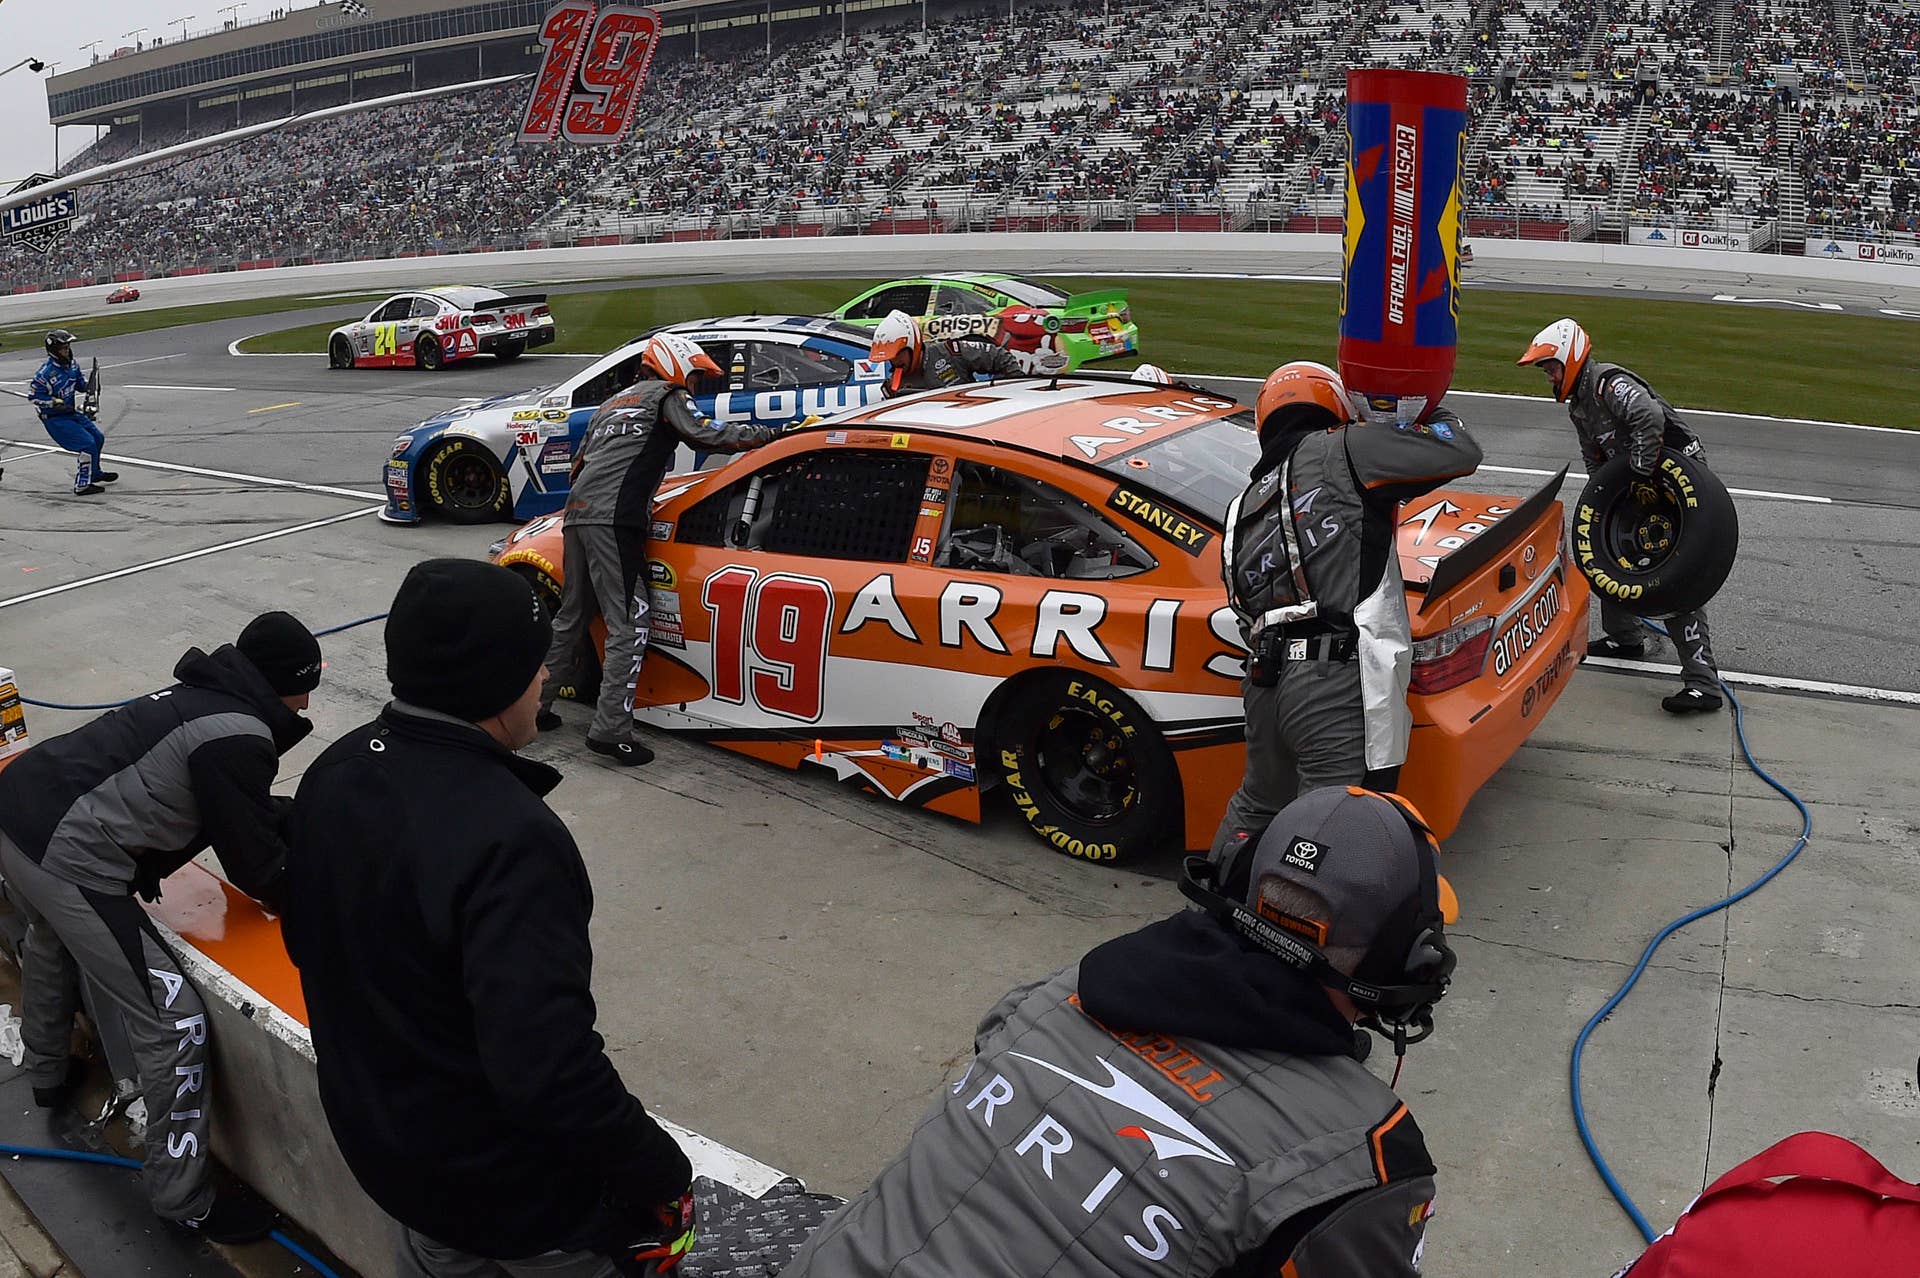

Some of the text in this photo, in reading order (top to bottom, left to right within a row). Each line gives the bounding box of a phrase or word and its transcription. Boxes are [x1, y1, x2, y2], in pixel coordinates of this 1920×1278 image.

[516, 1, 663, 144] 19
[1395, 126, 1416, 193] NASCAR
[10, 198, 68, 228] LOWE'S
[15, 222, 65, 240] RACING
[1406, 227, 1414, 242] OF
[1701, 234, 1740, 247] QuikTrip
[1877, 247, 1914, 261] QuikTrip
[1389, 223, 1407, 324] OFFICIAL FUEL
[434, 313, 460, 330] 3M
[503, 312, 528, 329] 3M
[928, 316, 993, 336] CRISPY
[374, 323, 397, 356] 24
[517, 432, 538, 444] 3M
[592, 423, 643, 439] RRIS
[1070, 397, 1234, 458] ARRIS
[429, 442, 463, 504] GOODYEAR
[1661, 458, 1697, 508] EAGLE
[494, 477, 509, 512] EAGLE
[1114, 489, 1204, 546] STANLEY
[499, 548, 554, 572] GOODYEAR
[912, 537, 931, 555] J5
[1245, 515, 1340, 587] ARIS
[1577, 504, 1642, 600] GOODYEAR
[537, 572, 561, 595] EAG
[1451, 600, 1484, 626] CAMRY
[1494, 582, 1560, 676] arris.com
[624, 595, 650, 712] ARRIS
[703, 563, 834, 725] 19
[1536, 641, 1571, 702] TOYOTA
[912, 711, 934, 723] Sport
[1067, 681, 1136, 738] EAGLE
[899, 728, 926, 741] LINCOLN
[1001, 750, 1117, 860] GOODYEAR
[1285, 854, 1315, 871] TOYOTA
[1232, 908, 1256, 928] RACING
[1256, 922, 1314, 963] COMMUNICATIONS!
[148, 968, 207, 1158] ARRIS
[953, 1064, 1183, 1261] RRIS
